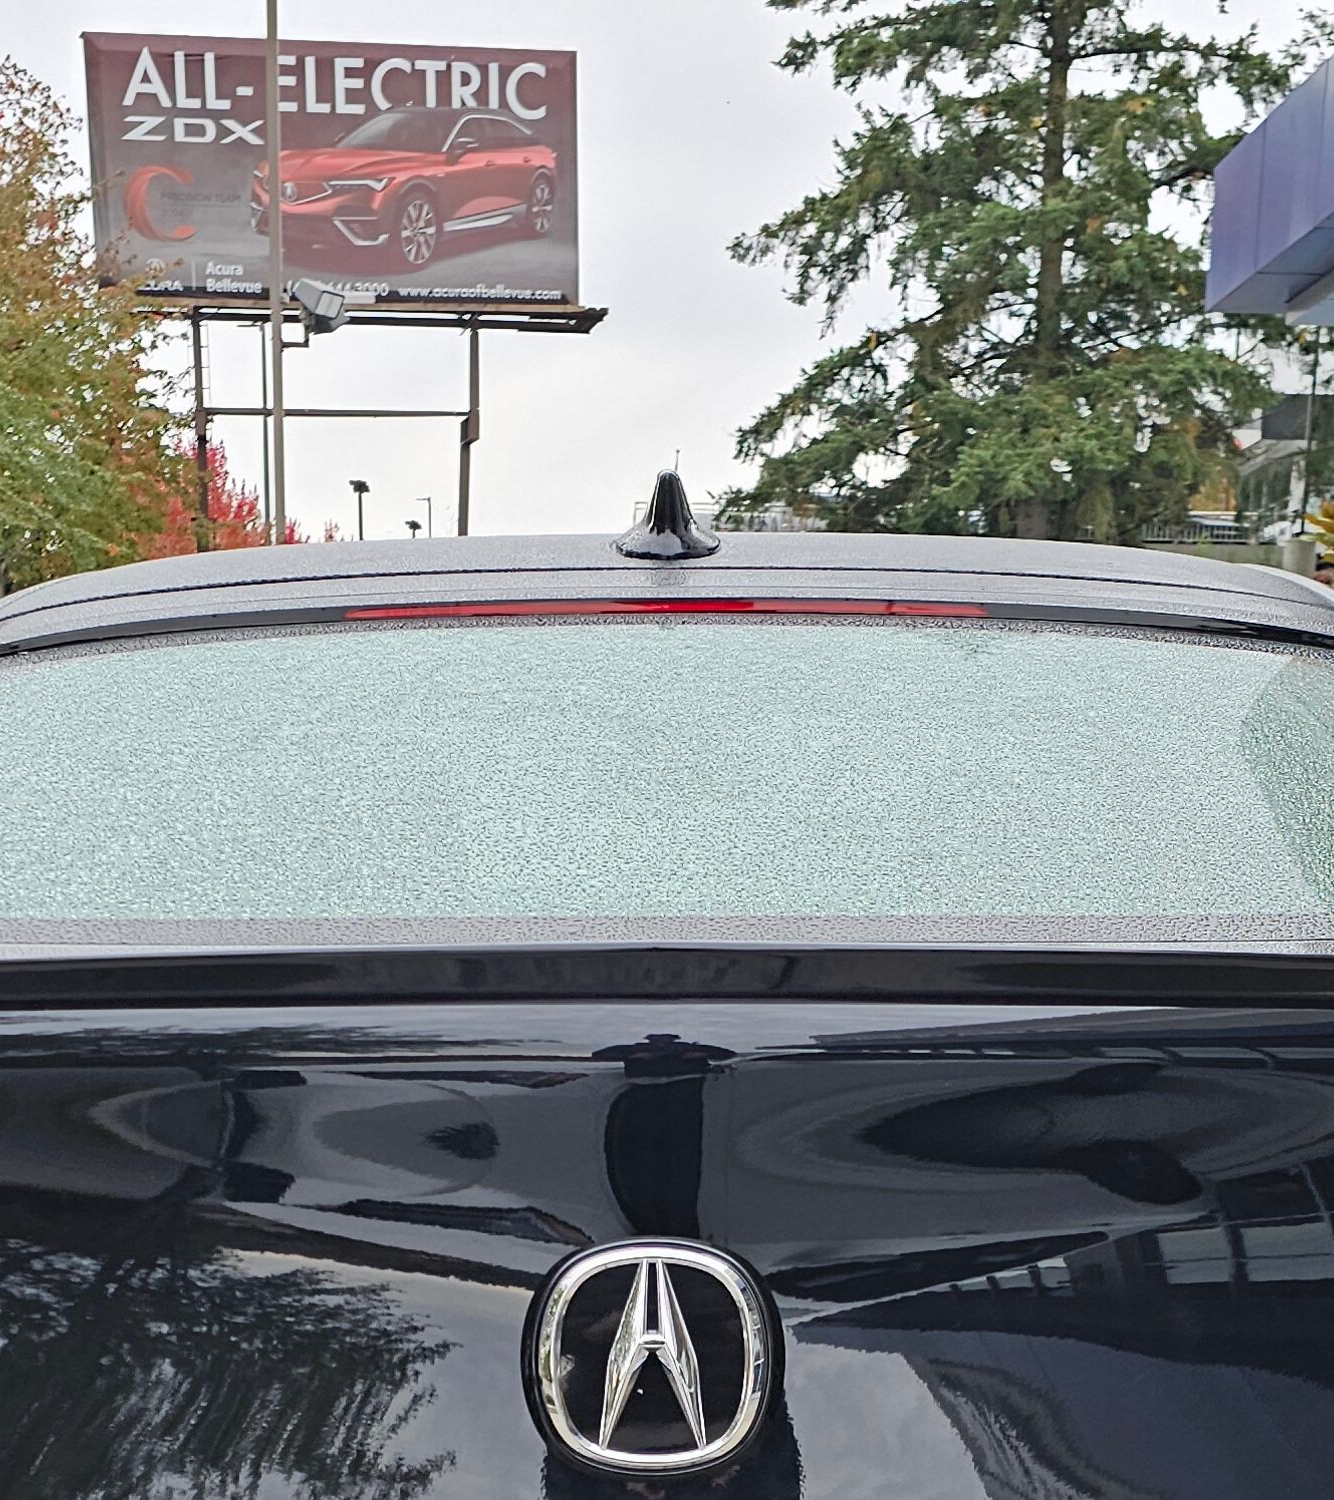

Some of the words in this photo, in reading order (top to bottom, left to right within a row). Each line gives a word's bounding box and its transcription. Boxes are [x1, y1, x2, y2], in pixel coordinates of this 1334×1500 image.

[122, 115, 265, 146] ZDX
[205, 261, 244, 276] Acura
[206, 278, 263, 294] Bellevue
[398, 283, 562, 300] www.acuraofbellevue.com
